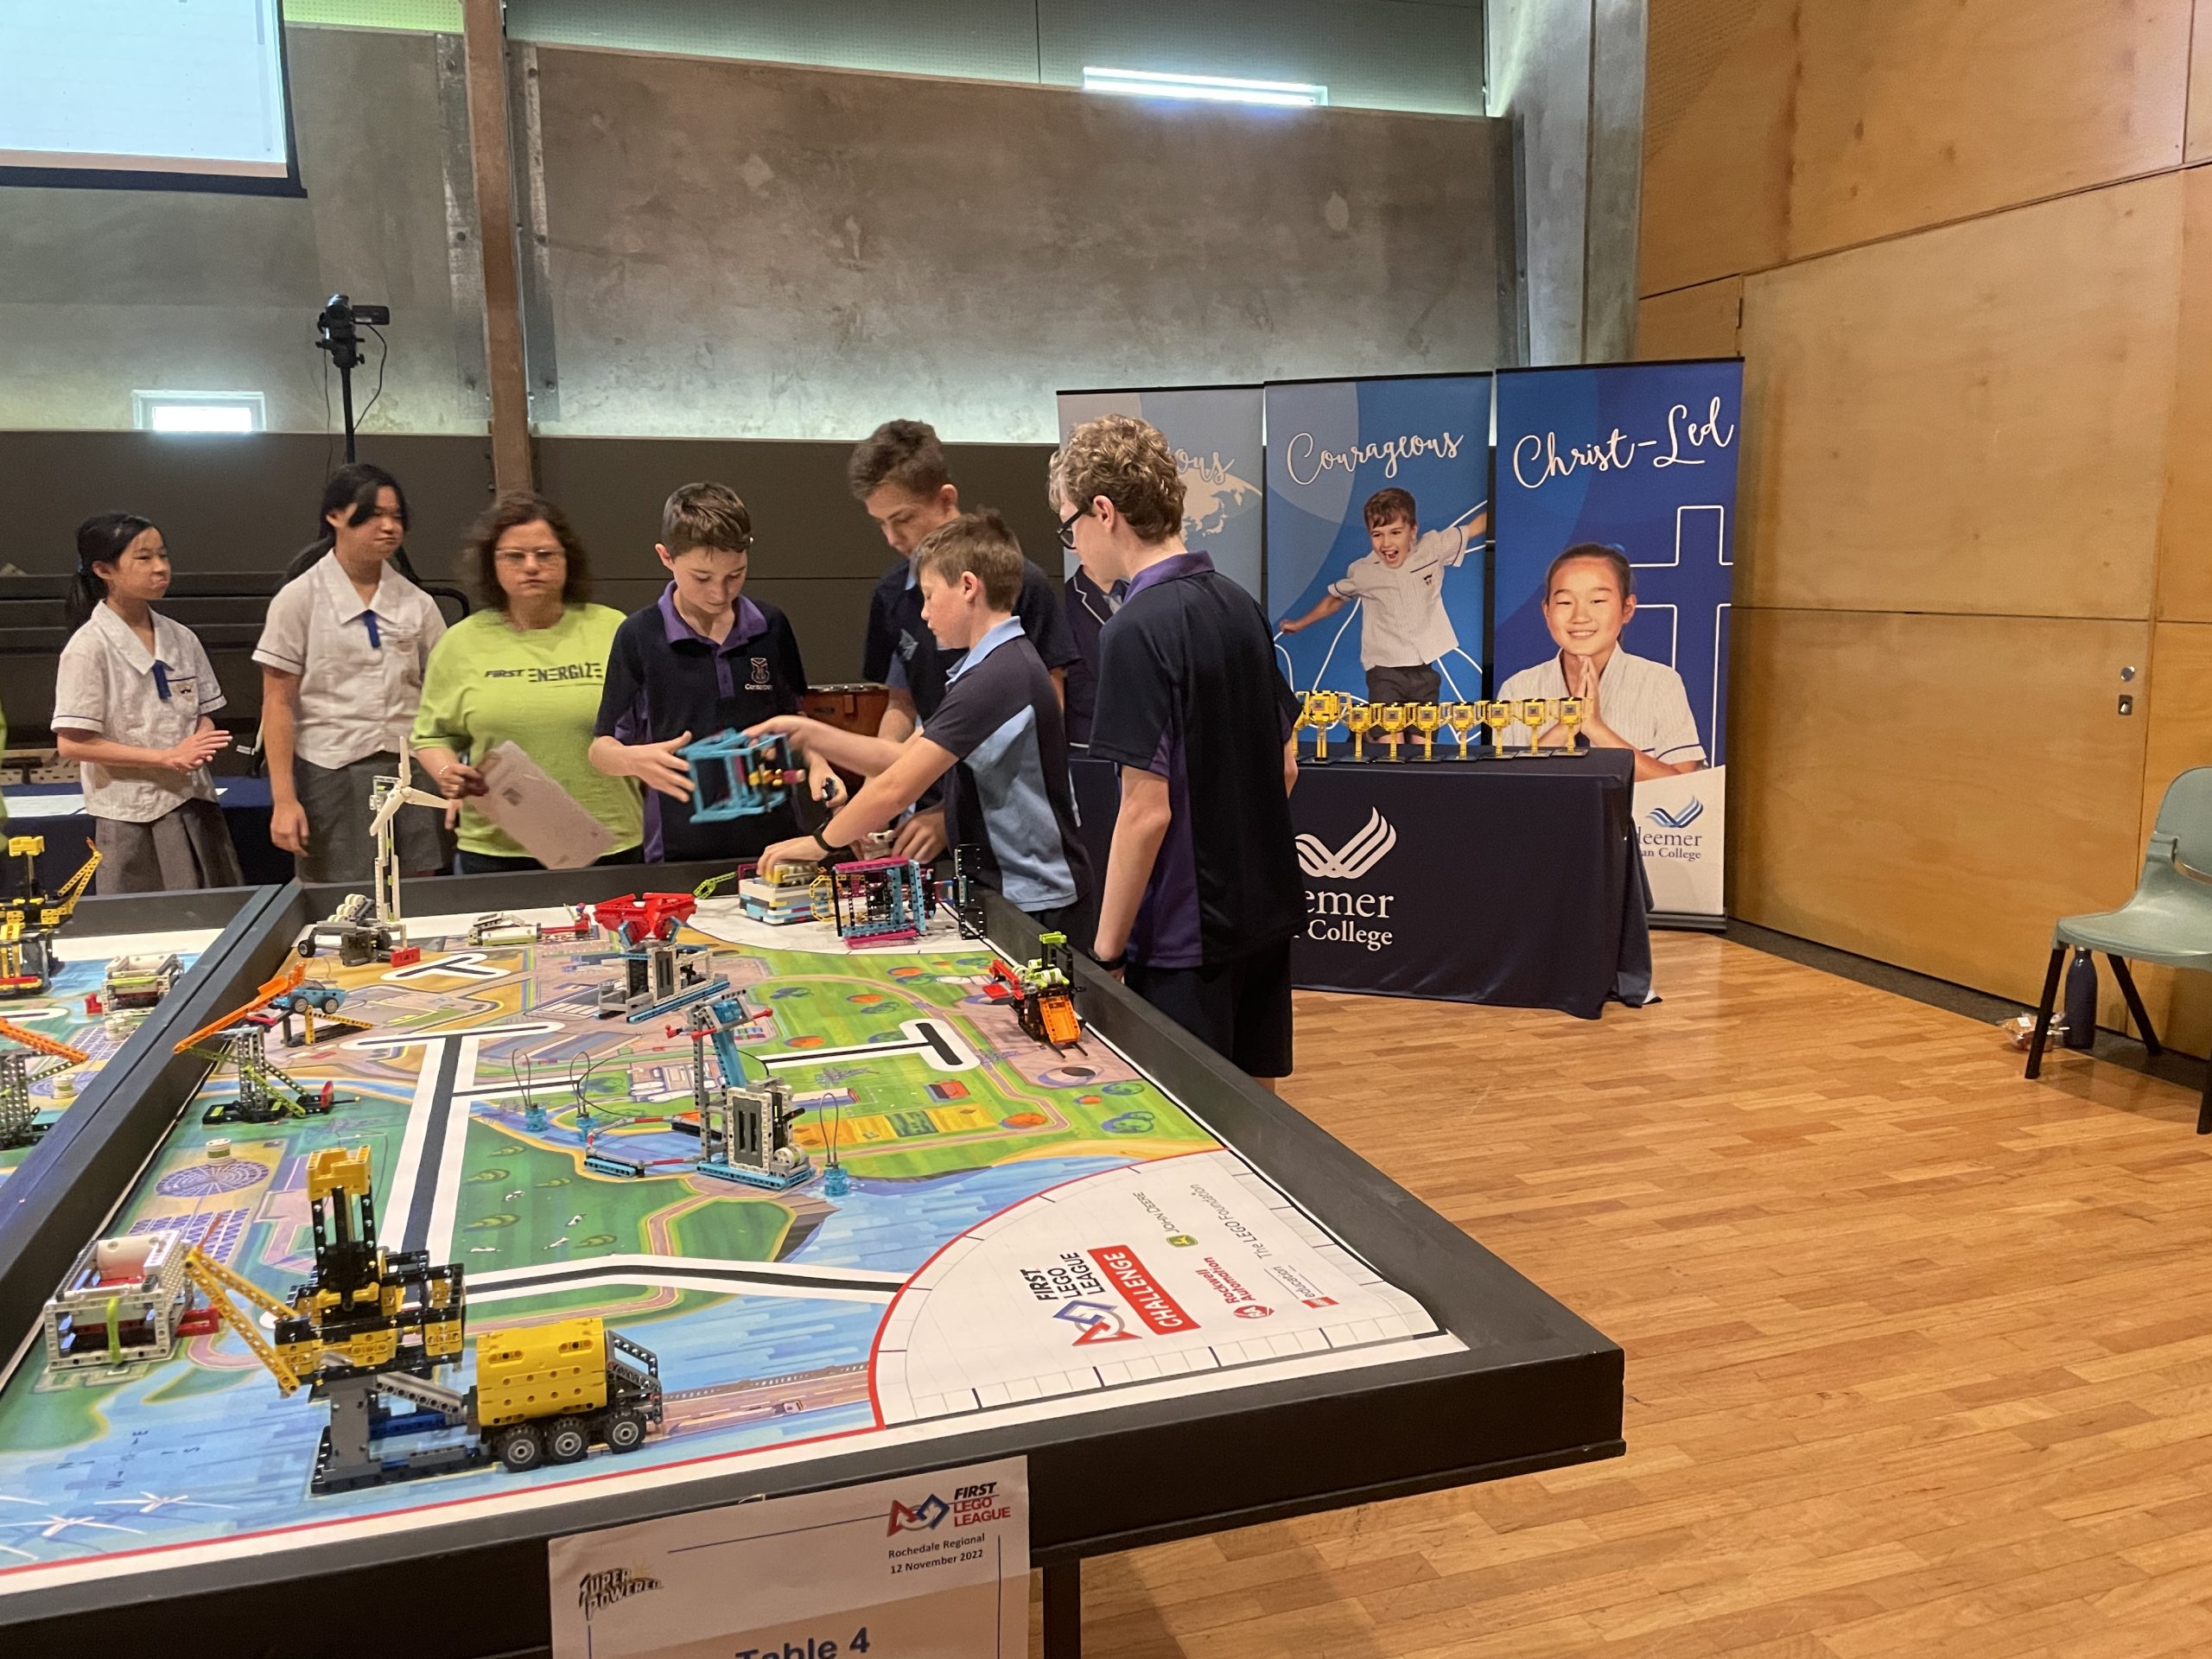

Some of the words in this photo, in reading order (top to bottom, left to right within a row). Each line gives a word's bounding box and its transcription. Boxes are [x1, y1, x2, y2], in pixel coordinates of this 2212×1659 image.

[1287, 431, 1465, 486] Courageous
[1512, 396, 1735, 489] Christ-Led
[1658, 847, 1701, 862] College
[1307, 918, 1393, 951] College
[1190, 1184, 1234, 1221] Foundation
[1153, 1212, 1180, 1233] JOHN
[1224, 1221, 1258, 1243] LEGO
[1252, 1243, 1273, 1260] The
[1020, 1268, 1059, 1301] FIRST
[1046, 1267, 1083, 1300] LEGO
[1059, 1251, 1106, 1295] LEAGUE
[1103, 1251, 1184, 1328] CHALLENGE
[1195, 1268, 1240, 1304] Rockwell
[1203, 1256, 1256, 1302] Automation
[1273, 1265, 1316, 1299] education
[953, 1497, 993, 1514] LEGO
[954, 1481, 997, 1501] FIRST
[954, 1506, 1012, 1528] LEAGUE
[888, 1542, 940, 1560] Rochedale
[943, 1532, 985, 1549] Regional
[891, 1563, 903, 1574] 12
[905, 1555, 957, 1572] November
[960, 1548, 984, 1562] 2022
[849, 1626, 870, 1654] 4
